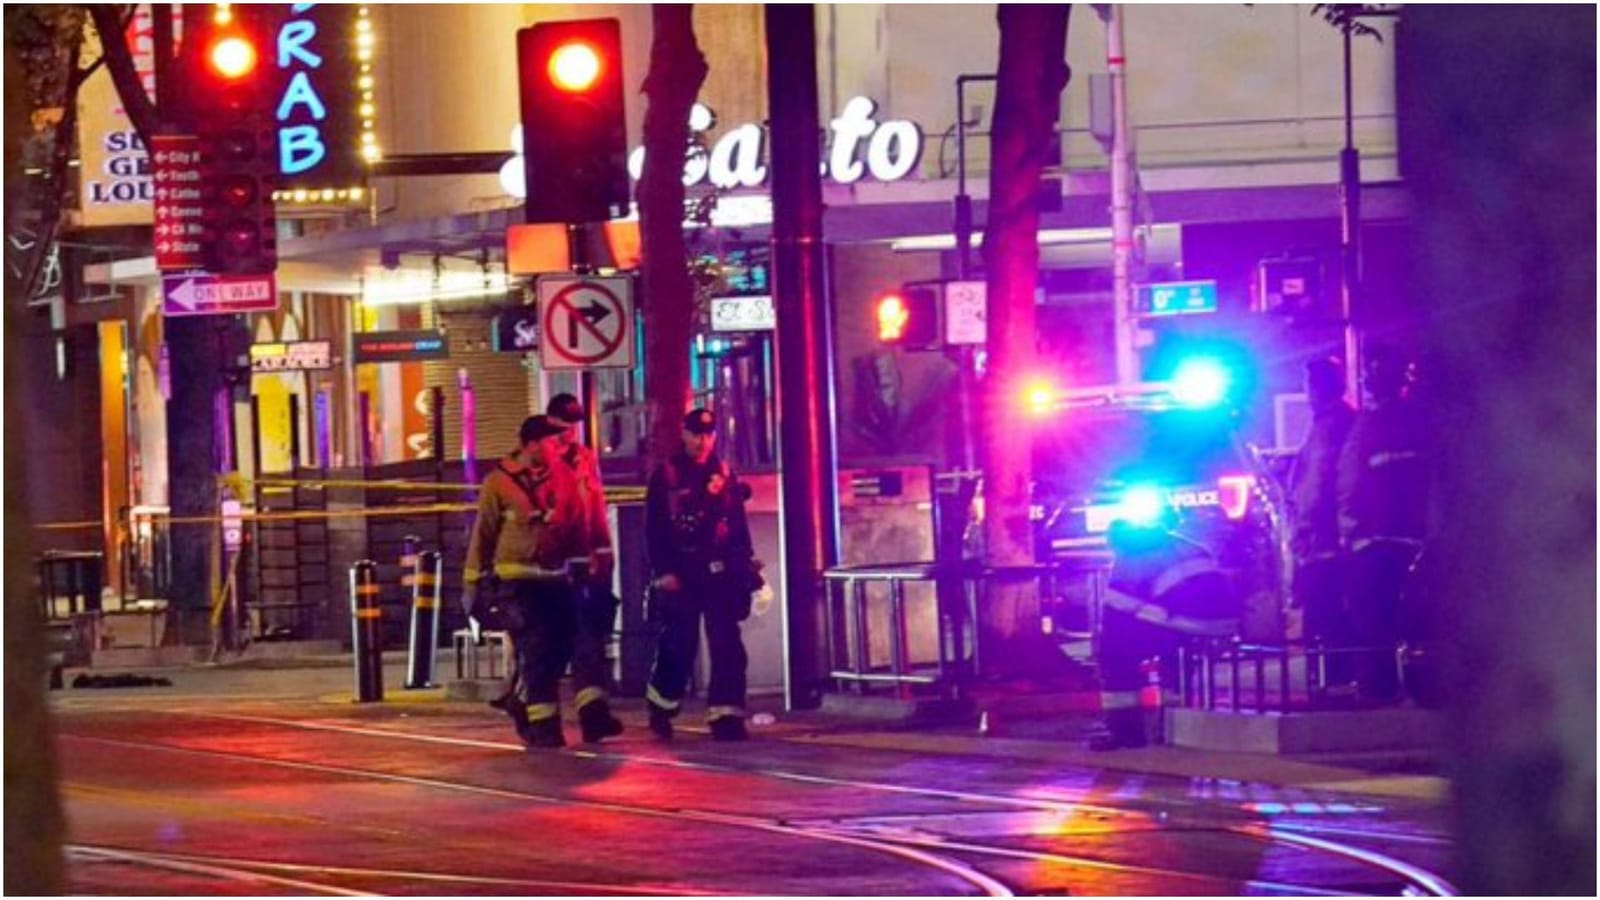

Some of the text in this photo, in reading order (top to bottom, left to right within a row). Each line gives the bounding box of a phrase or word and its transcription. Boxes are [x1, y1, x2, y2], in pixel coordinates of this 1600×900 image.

[277, 4, 327, 174] RAB
[168, 151, 189, 164] City
[109, 157, 150, 177] GE
[92, 183, 154, 203] LOU
[231, 284, 264, 299] WAY
[1174, 490, 1220, 507] POLICE
